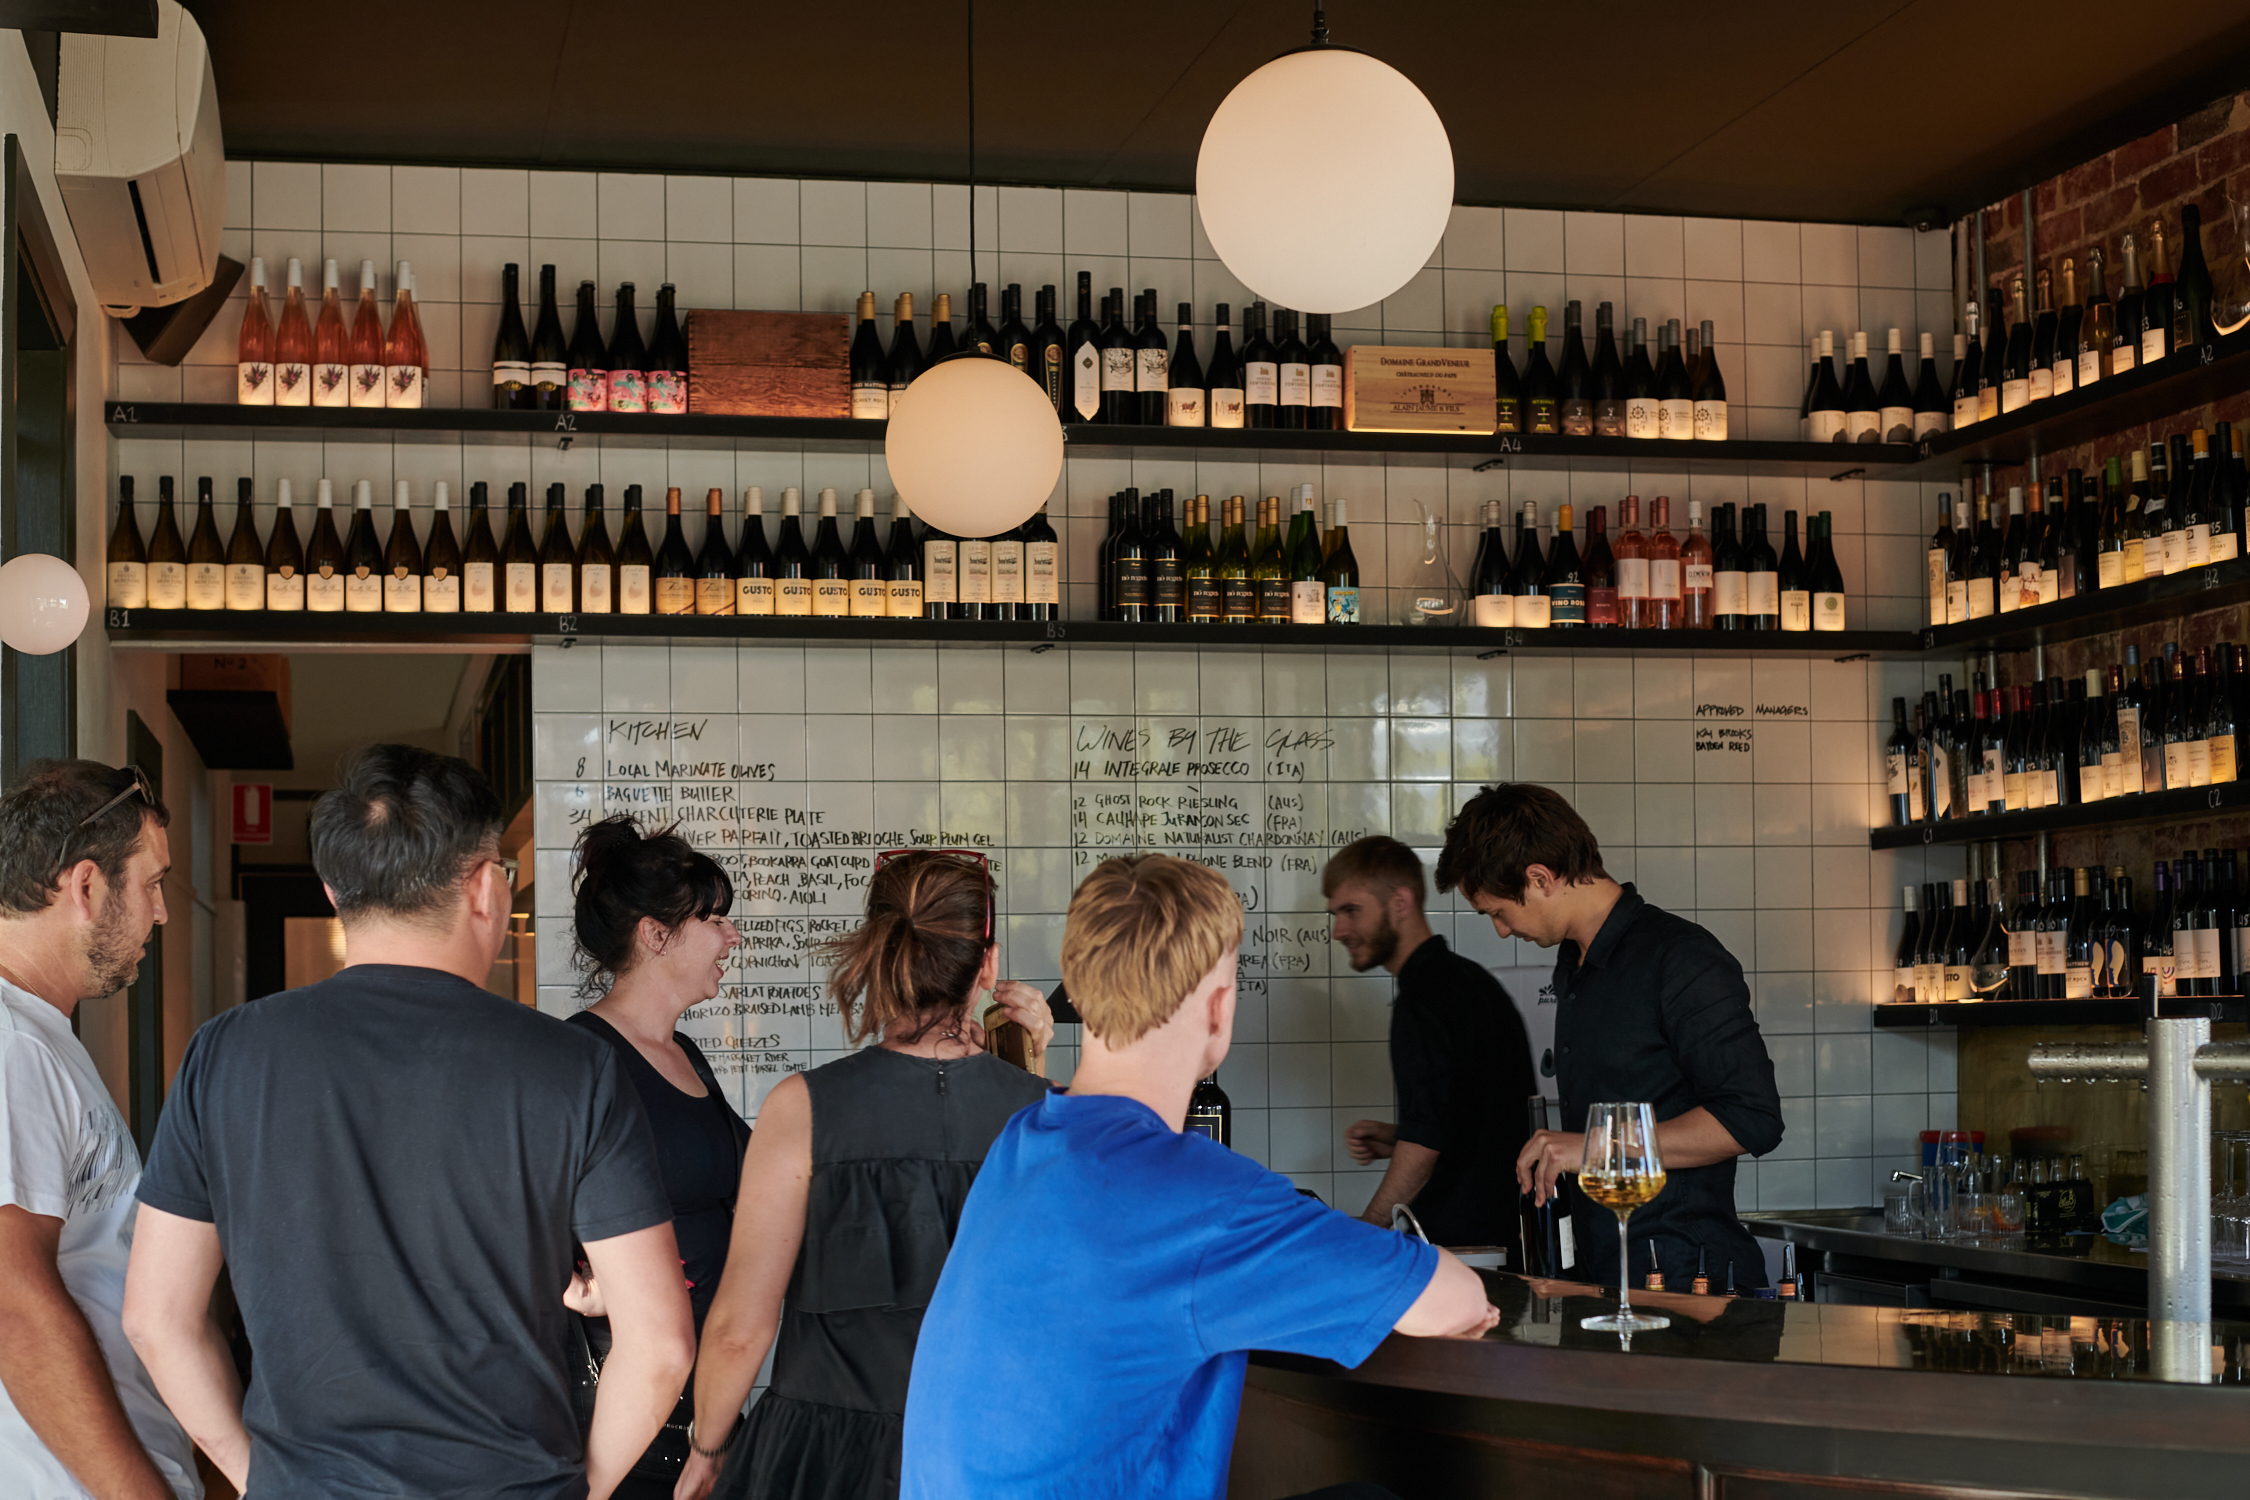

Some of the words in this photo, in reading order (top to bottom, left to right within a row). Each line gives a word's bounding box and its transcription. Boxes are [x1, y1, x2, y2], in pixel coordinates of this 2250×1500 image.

[1380, 357, 1415, 367] DOMAINE
[2200, 344, 2214, 365] A2
[112, 405, 139, 423] A1
[555, 415, 578, 432] A2
[1500, 436, 1522, 453] A4
[1567, 571, 1580, 583] 92
[2205, 568, 2219, 590] B2
[743, 585, 772, 595] GUSTO
[783, 586, 811, 596] GUSTO
[819, 586, 848, 596] GUSTO
[859, 587, 886, 597] GUSTO
[891, 587, 921, 598] GUSTO
[1551, 599, 1569, 607] VINO
[110, 609, 130, 628] B1
[559, 615, 578, 633] B2
[1046, 622, 1066, 639] B3
[1505, 629, 1523, 647] B4
[1695, 703, 1745, 717] APPROVED
[1755, 703, 1809, 717] MANAGERS
[608, 718, 709, 746] KITCHEN
[1718, 728, 1753, 741] BROOKS
[1076, 725, 1152, 752] WINES
[1167, 727, 1198, 755] BY
[1206, 727, 1251, 755] THE
[1265, 728, 1336, 757] GLASS
[1728, 741, 1751, 753] REED
[576, 757, 586, 778] 8
[607, 760, 651, 778] LOCAL
[655, 759, 727, 779] MARINATE
[731, 762, 776, 782] OLIVES
[1073, 760, 1091, 779] 14
[1104, 760, 1182, 778] INTEGRALE
[1186, 761, 1250, 777] PROSECCO
[1267, 761, 1305, 783] (ITA)
[575, 784, 584, 798] 6
[605, 785, 673, 804] BAGUETTE
[680, 785, 737, 802] BUTTER
[1073, 796, 1088, 810] 12
[1095, 793, 1132, 809] GHOST
[1138, 795, 1173, 809] ROCK
[1178, 794, 1239, 810] RIESLING
[1268, 793, 1304, 812] (AUS)
[2208, 788, 2222, 809] C2
[568, 808, 592, 826] 34
[677, 805, 779, 825] CHARCUTERIE
[784, 808, 826, 826] PLATE
[1073, 811, 1088, 829] 14
[1226, 813, 1251, 827] SEC
[791, 831, 849, 848] TOASTED
[909, 829, 938, 847] SOUR
[940, 831, 970, 847] PLUM
[973, 833, 995, 847] GEL
[1073, 831, 1088, 848] 12
[1095, 831, 1156, 846] DOMAINE
[1164, 831, 1235, 846] NATURALIST
[1239, 829, 1325, 848] CHARDONNAY
[810, 854, 838, 869] GOAT
[840, 855, 871, 870] CURD
[1075, 851, 1090, 866] 12
[1232, 855, 1273, 869] BLEND
[1281, 853, 1318, 875] (FRA)
[752, 872, 790, 888] PEACH
[789, 890, 827, 905] AIOLI
[1252, 925, 1292, 947] NOIR
[1273, 952, 1311, 973] (FRA)
[718, 986, 765, 999] SARLAT
[768, 985, 822, 1000] POTATOES
[1237, 980, 1268, 995] ITA)
[732, 1003, 781, 1017] BRAISED
[782, 1003, 815, 1017] LAMB
[1929, 1008, 1939, 1025] D1
[2210, 1002, 2224, 1021] D2
[764, 1052, 790, 1063] RIVER
